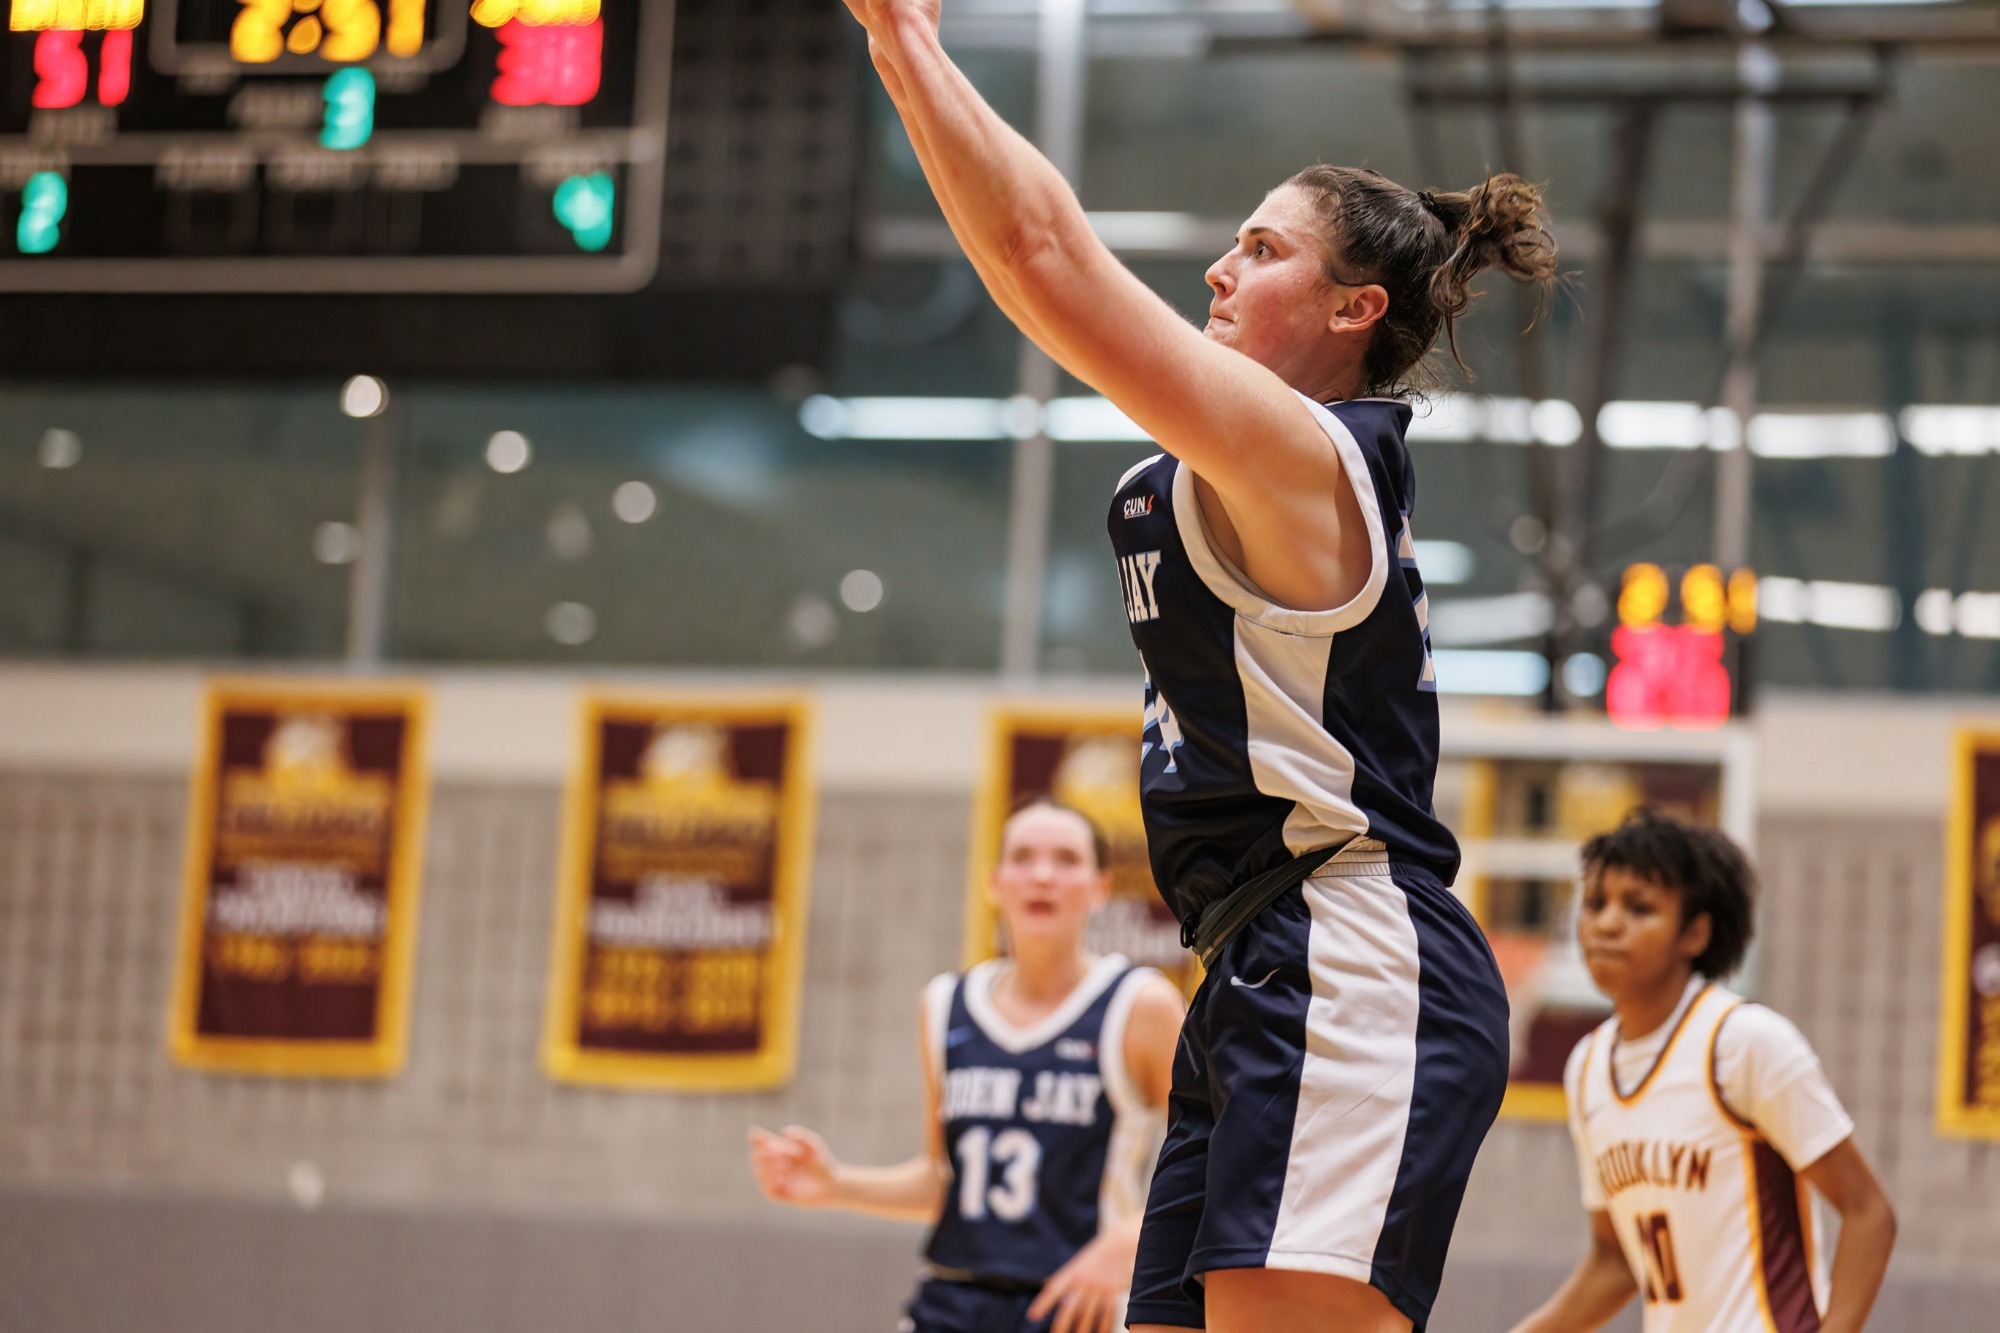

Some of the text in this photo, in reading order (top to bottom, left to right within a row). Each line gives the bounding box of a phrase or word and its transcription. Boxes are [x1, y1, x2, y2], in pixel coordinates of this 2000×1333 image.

[1120, 550, 1161, 624] JAY
[1021, 1071, 1101, 1126] JAY
[956, 1125, 1043, 1224] 13
